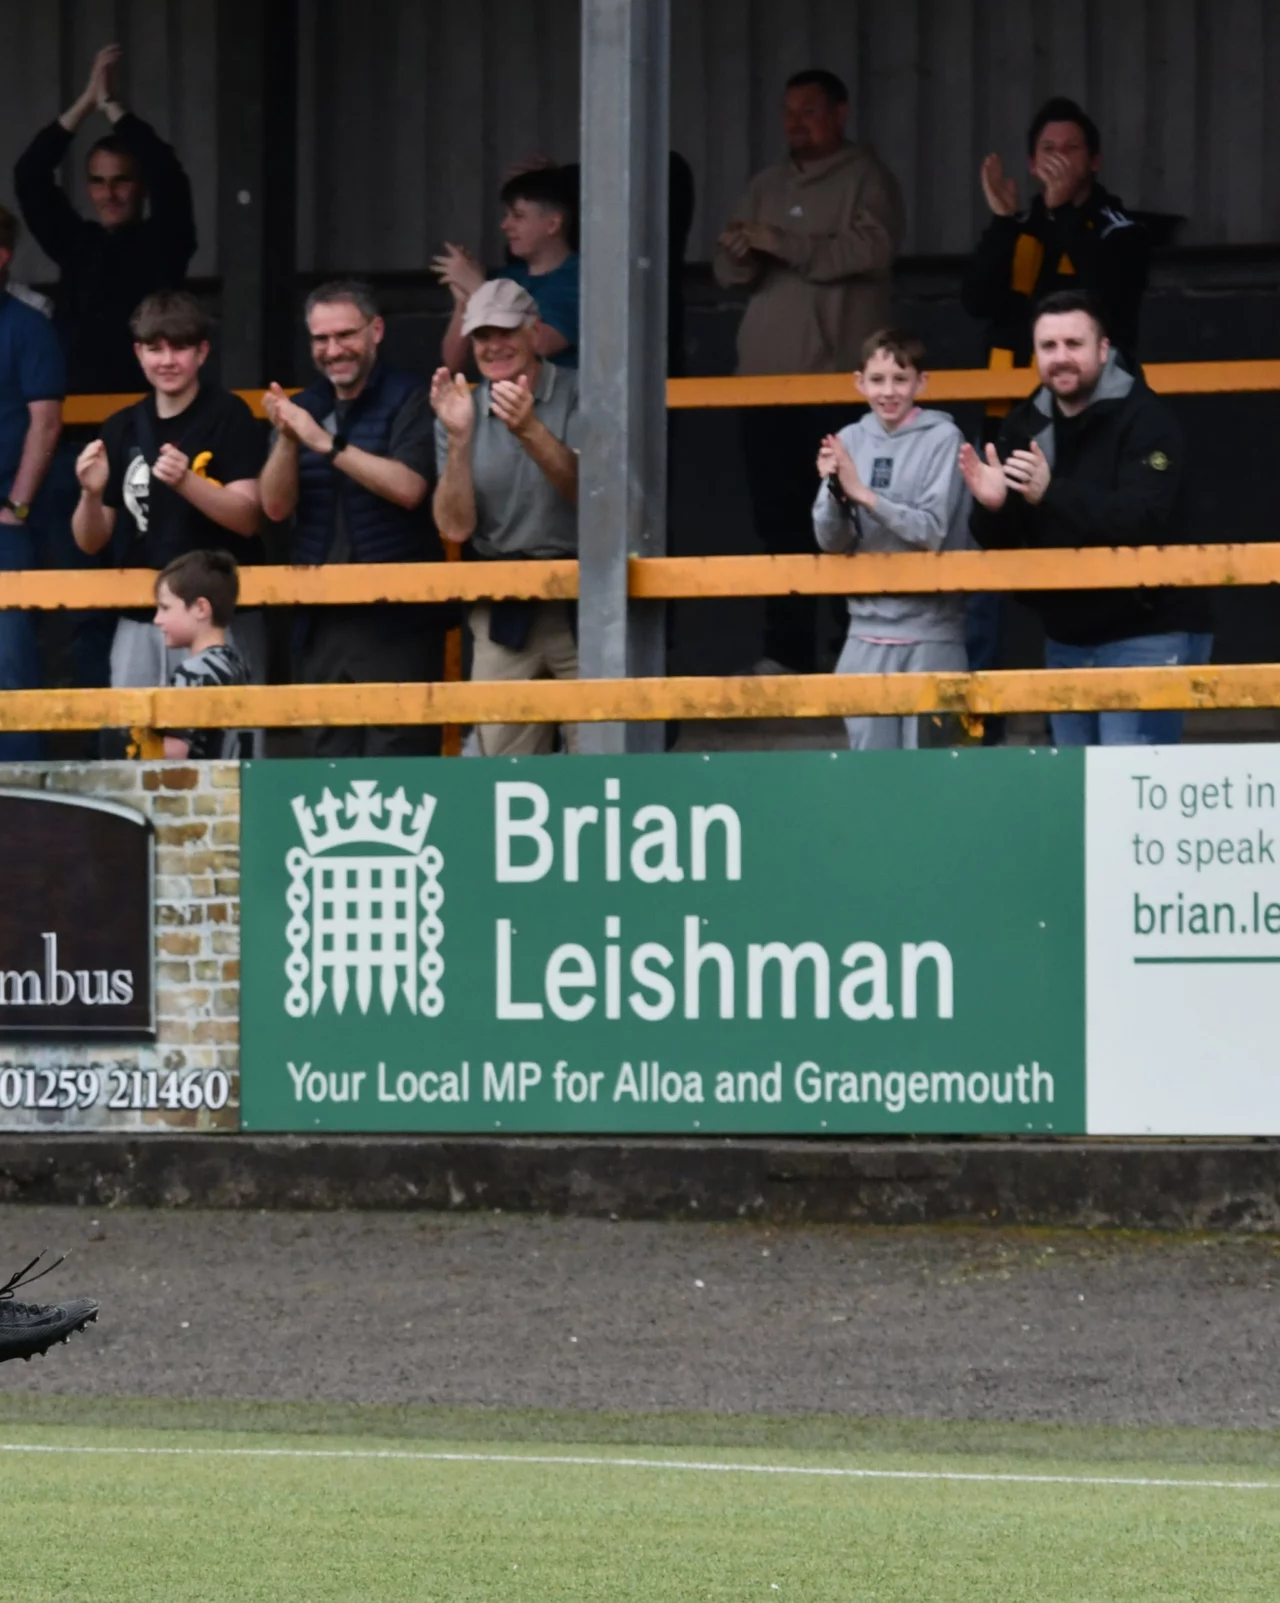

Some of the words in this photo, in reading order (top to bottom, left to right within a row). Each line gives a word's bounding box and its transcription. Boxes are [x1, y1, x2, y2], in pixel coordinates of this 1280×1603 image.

[1131, 775, 1167, 810] To
[1180, 776, 1234, 818] get
[1246, 774, 1275, 808] in
[492, 777, 743, 884] Brian
[1132, 833, 1165, 865] to
[1176, 828, 1276, 872] speak
[493, 914, 955, 1021] Leishman
[107, 1070, 229, 1110] 211460
[286, 1062, 366, 1103] Your
[377, 1061, 470, 1103] Local
[482, 1063, 541, 1102] MP
[552, 1062, 603, 1102] for
[613, 1062, 704, 1103] Alloa
[713, 1062, 784, 1103] and
[793, 1061, 1055, 1112] Grangemouth
